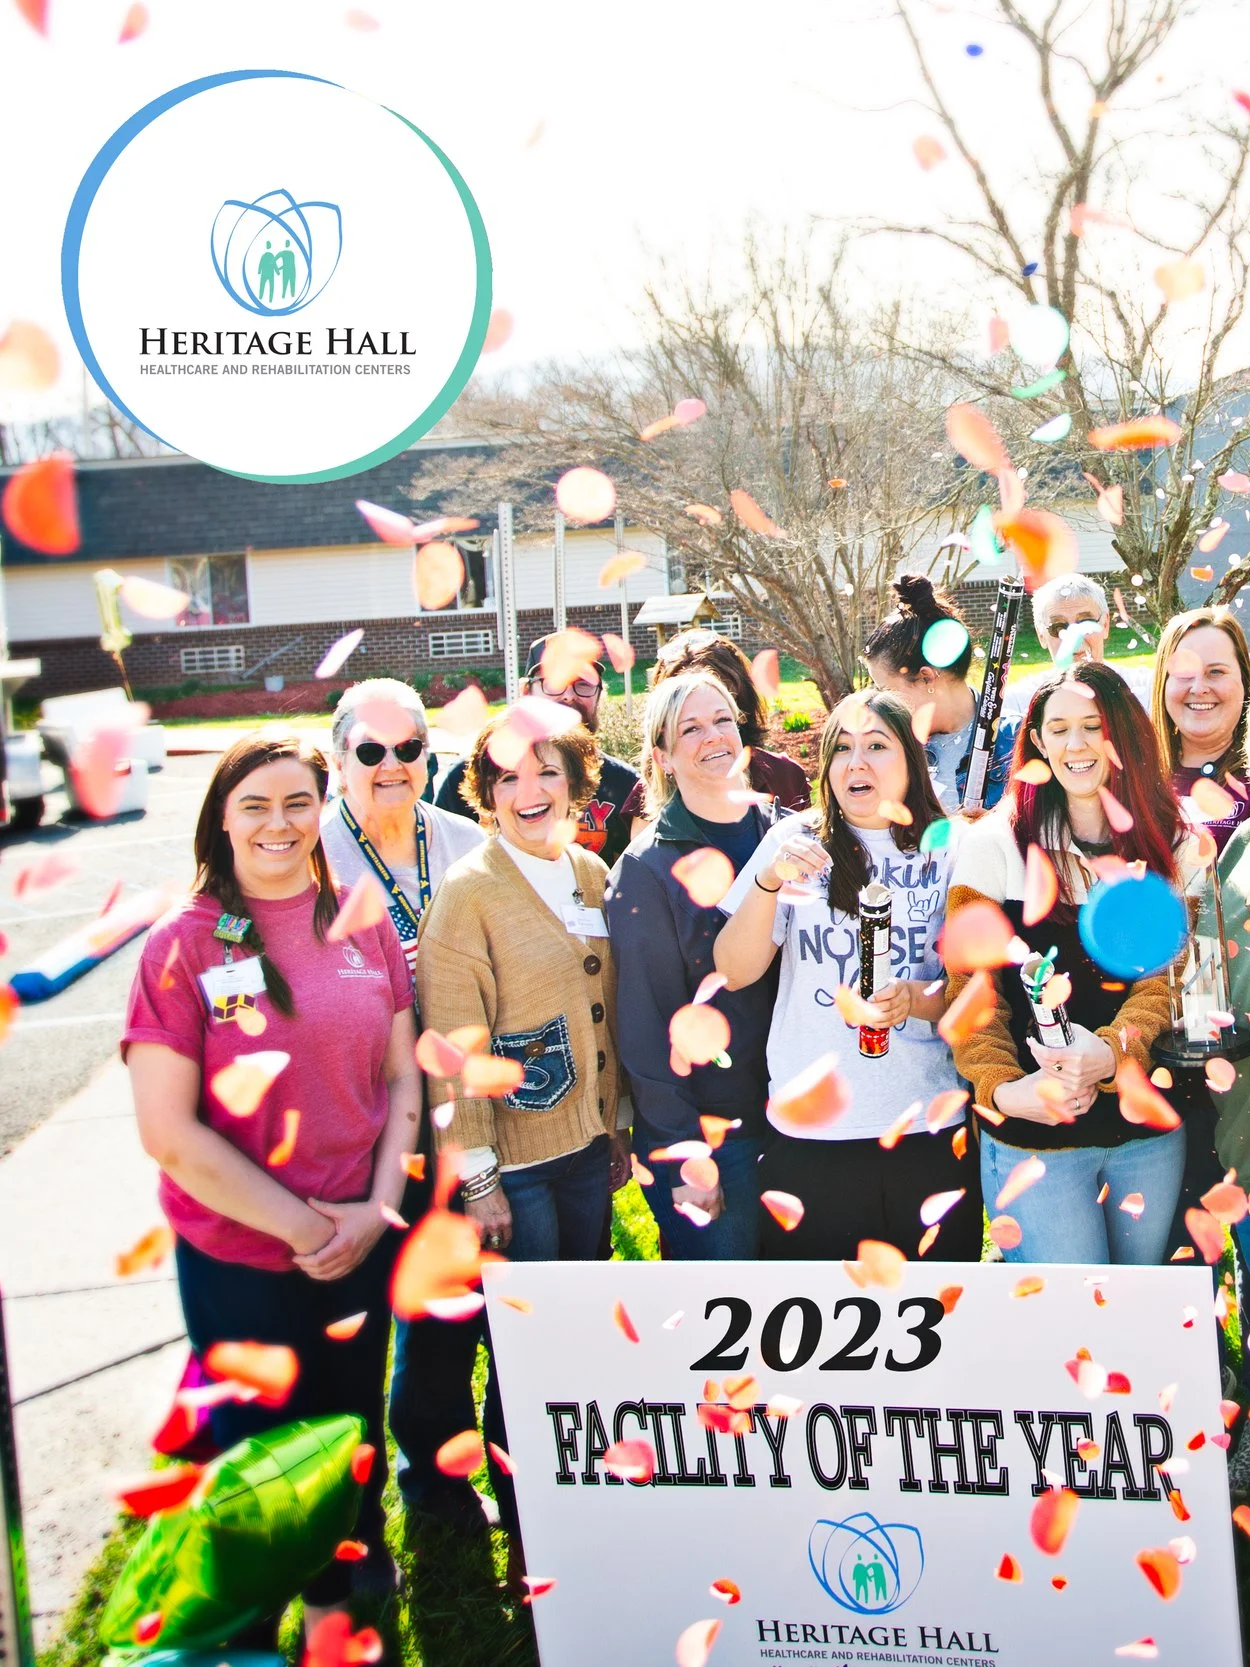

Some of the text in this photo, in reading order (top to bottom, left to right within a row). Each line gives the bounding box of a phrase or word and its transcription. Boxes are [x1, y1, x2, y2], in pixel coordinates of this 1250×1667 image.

[689, 1297, 945, 1372] 2023
[545, 1398, 1181, 1502] FACILITY OF THE YEAR
[756, 1619, 999, 1653] HERITAGE HALL
[760, 1648, 996, 1667] HEALTHCARE AND REHABILITATION CENTERS
